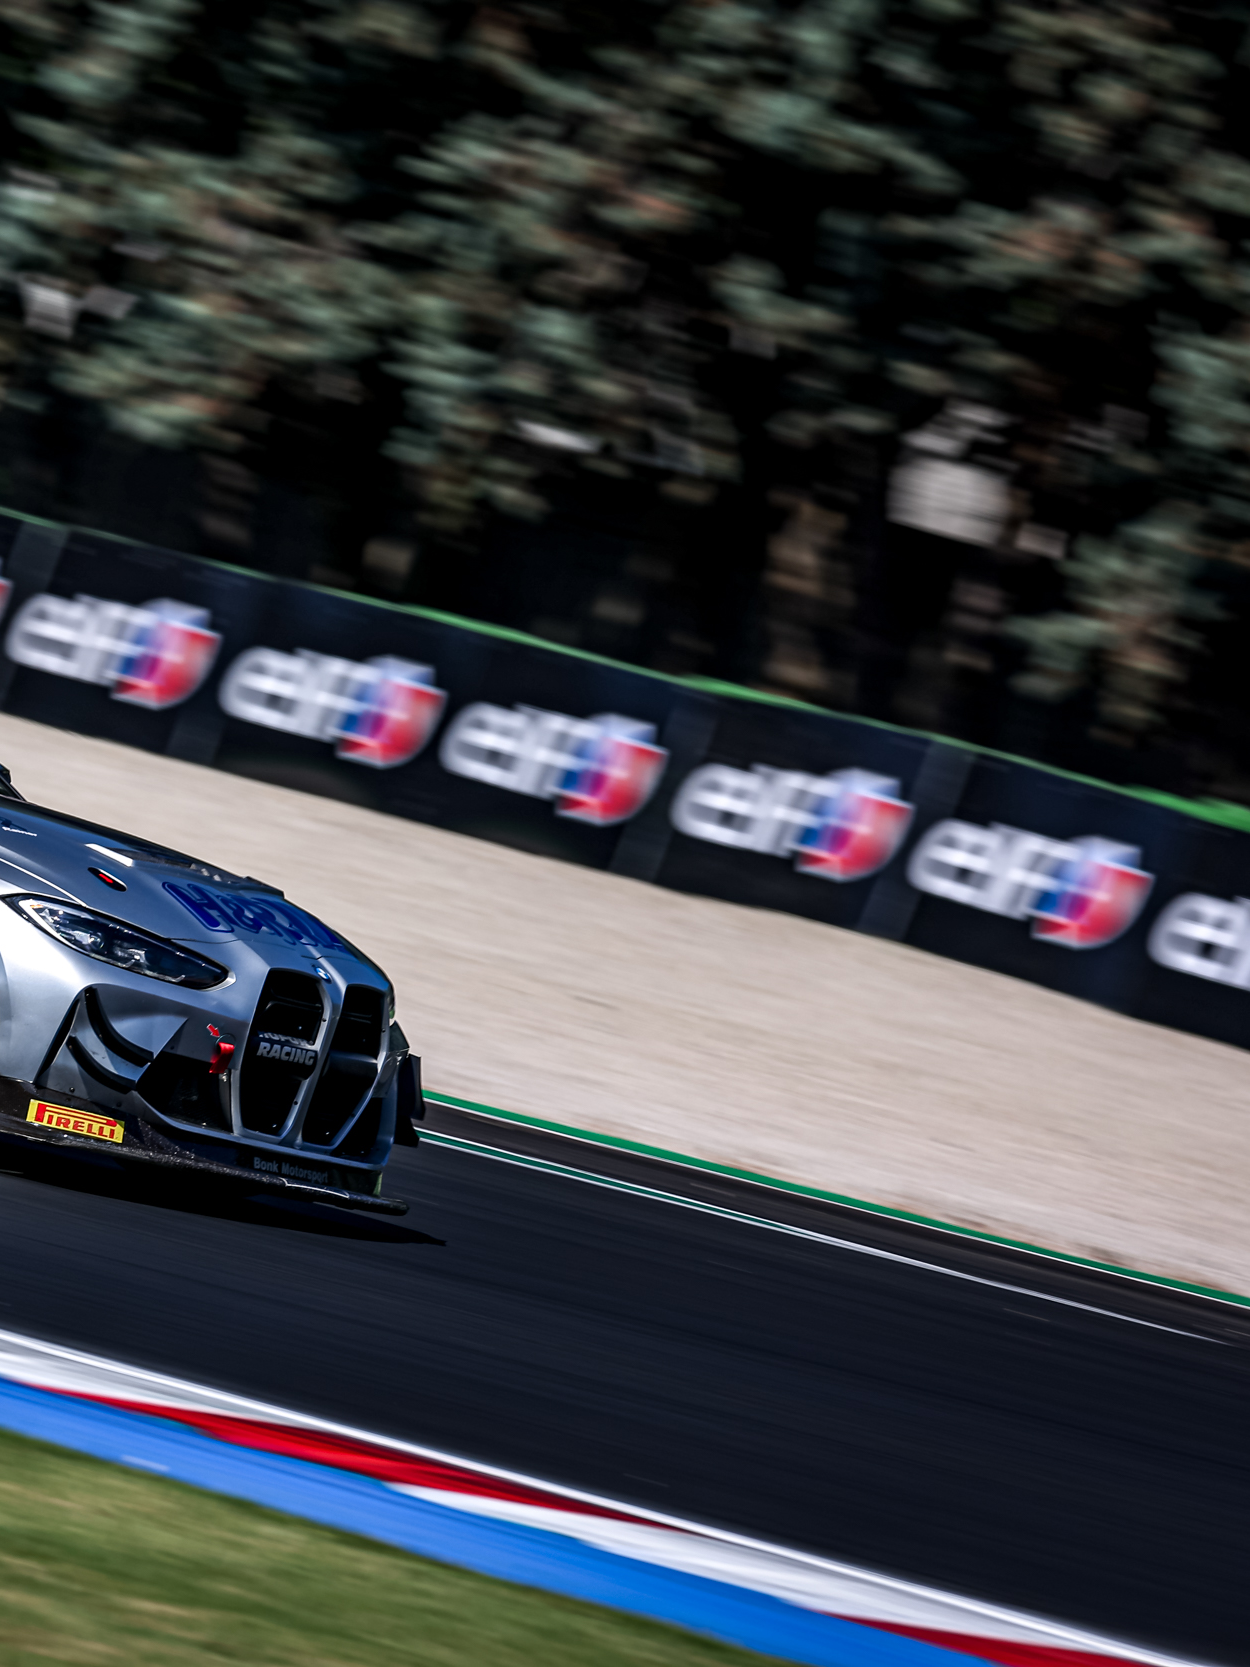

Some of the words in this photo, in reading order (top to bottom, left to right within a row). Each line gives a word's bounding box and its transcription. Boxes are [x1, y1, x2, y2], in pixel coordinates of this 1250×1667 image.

[256, 1041, 316, 1066] RACING
[34, 1102, 118, 1140] PIRELLI
[253, 1156, 279, 1173] Bonk
[281, 1162, 329, 1184] Motorsport
